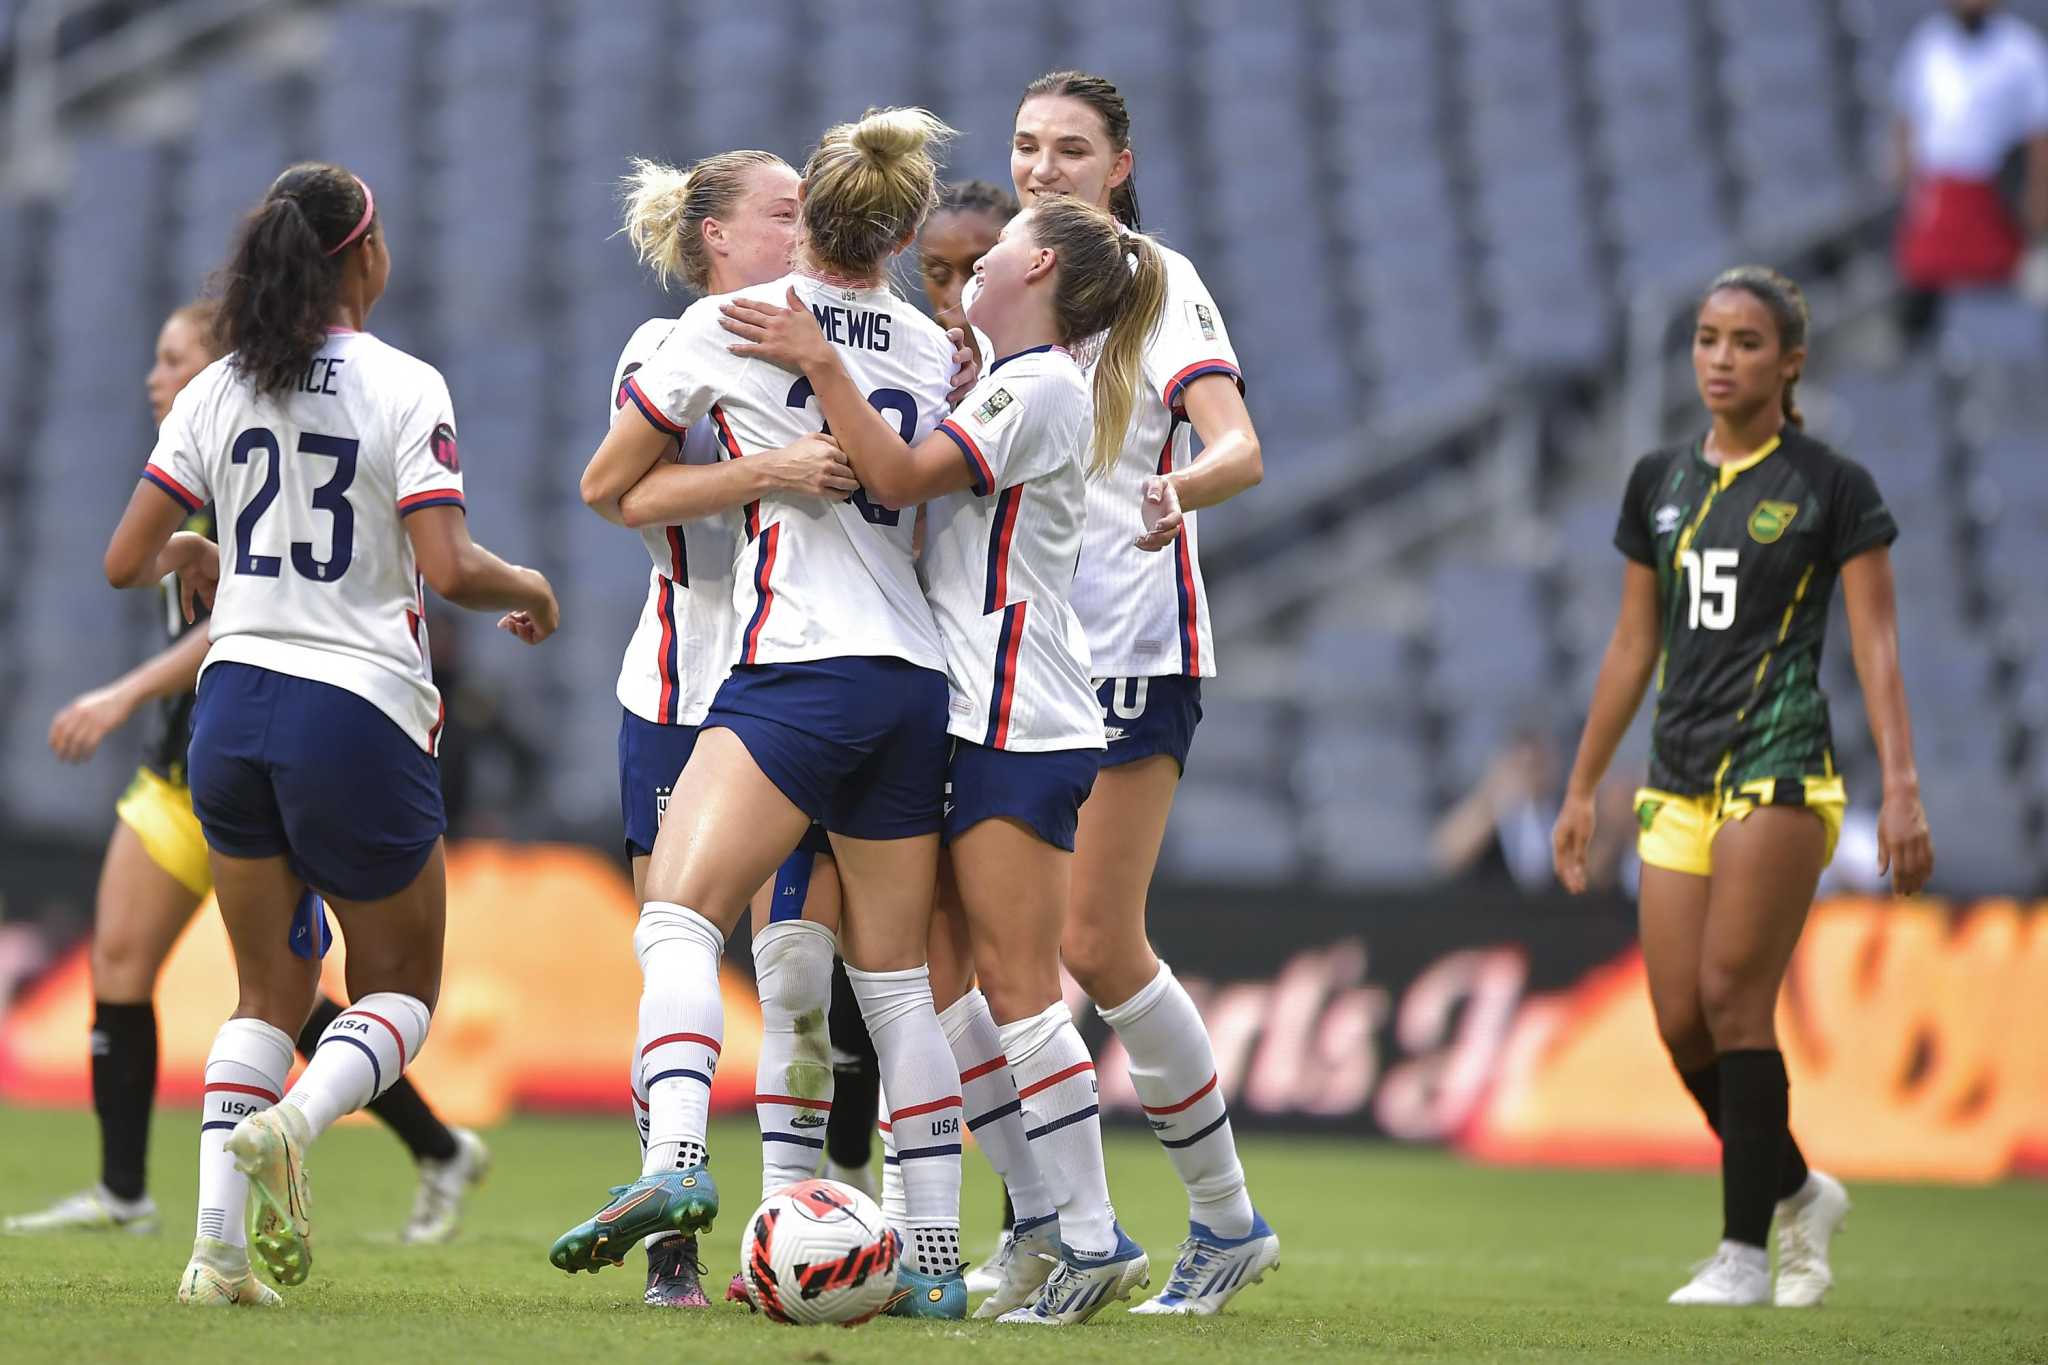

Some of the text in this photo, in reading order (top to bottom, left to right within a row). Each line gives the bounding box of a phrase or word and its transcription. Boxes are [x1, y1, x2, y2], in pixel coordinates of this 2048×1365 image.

[842, 291, 857, 302] USA
[812, 303, 892, 352] MEWIS
[231, 428, 360, 582] 23
[1681, 549, 1739, 630] 15
[332, 1020, 369, 1034] USA
[931, 1117, 959, 1136] USA
